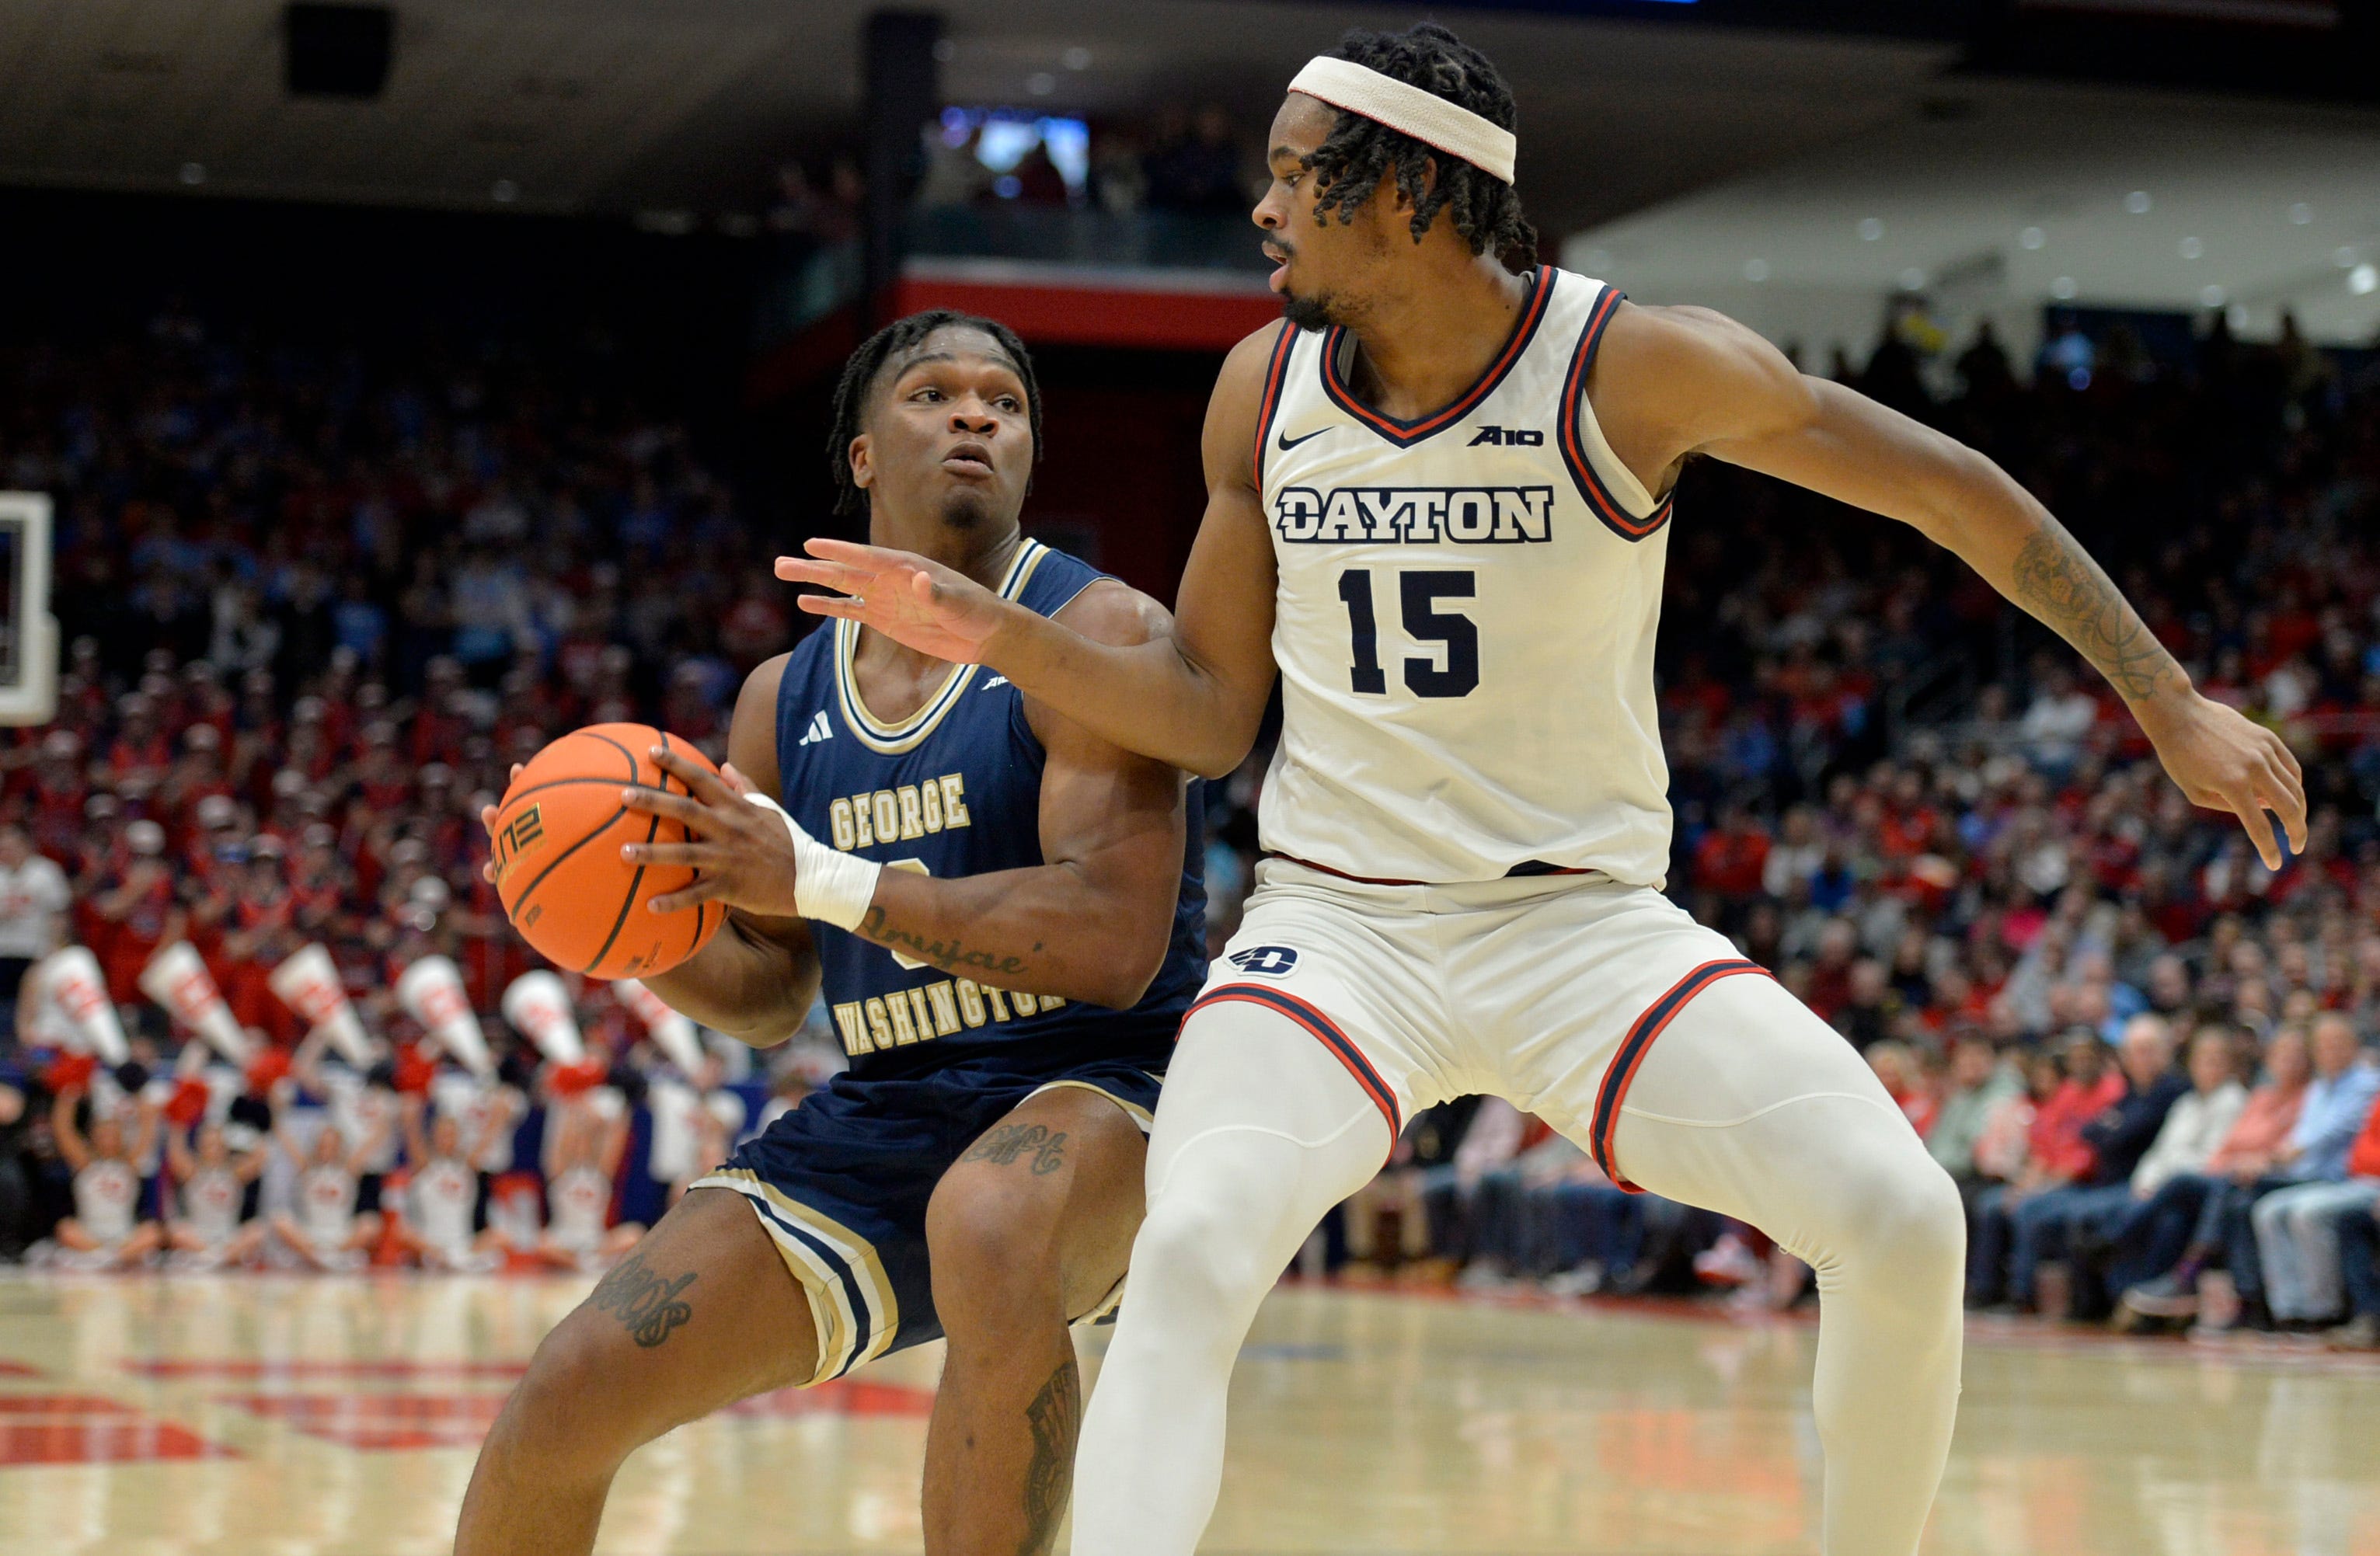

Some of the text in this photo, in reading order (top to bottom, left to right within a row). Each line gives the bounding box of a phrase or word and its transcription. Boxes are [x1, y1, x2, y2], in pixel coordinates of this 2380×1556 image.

[1466, 425, 1544, 447] A10
[1276, 486, 1555, 544] DAYTON
[1338, 569, 1479, 698] 15
[829, 772, 970, 851] GEORGE
